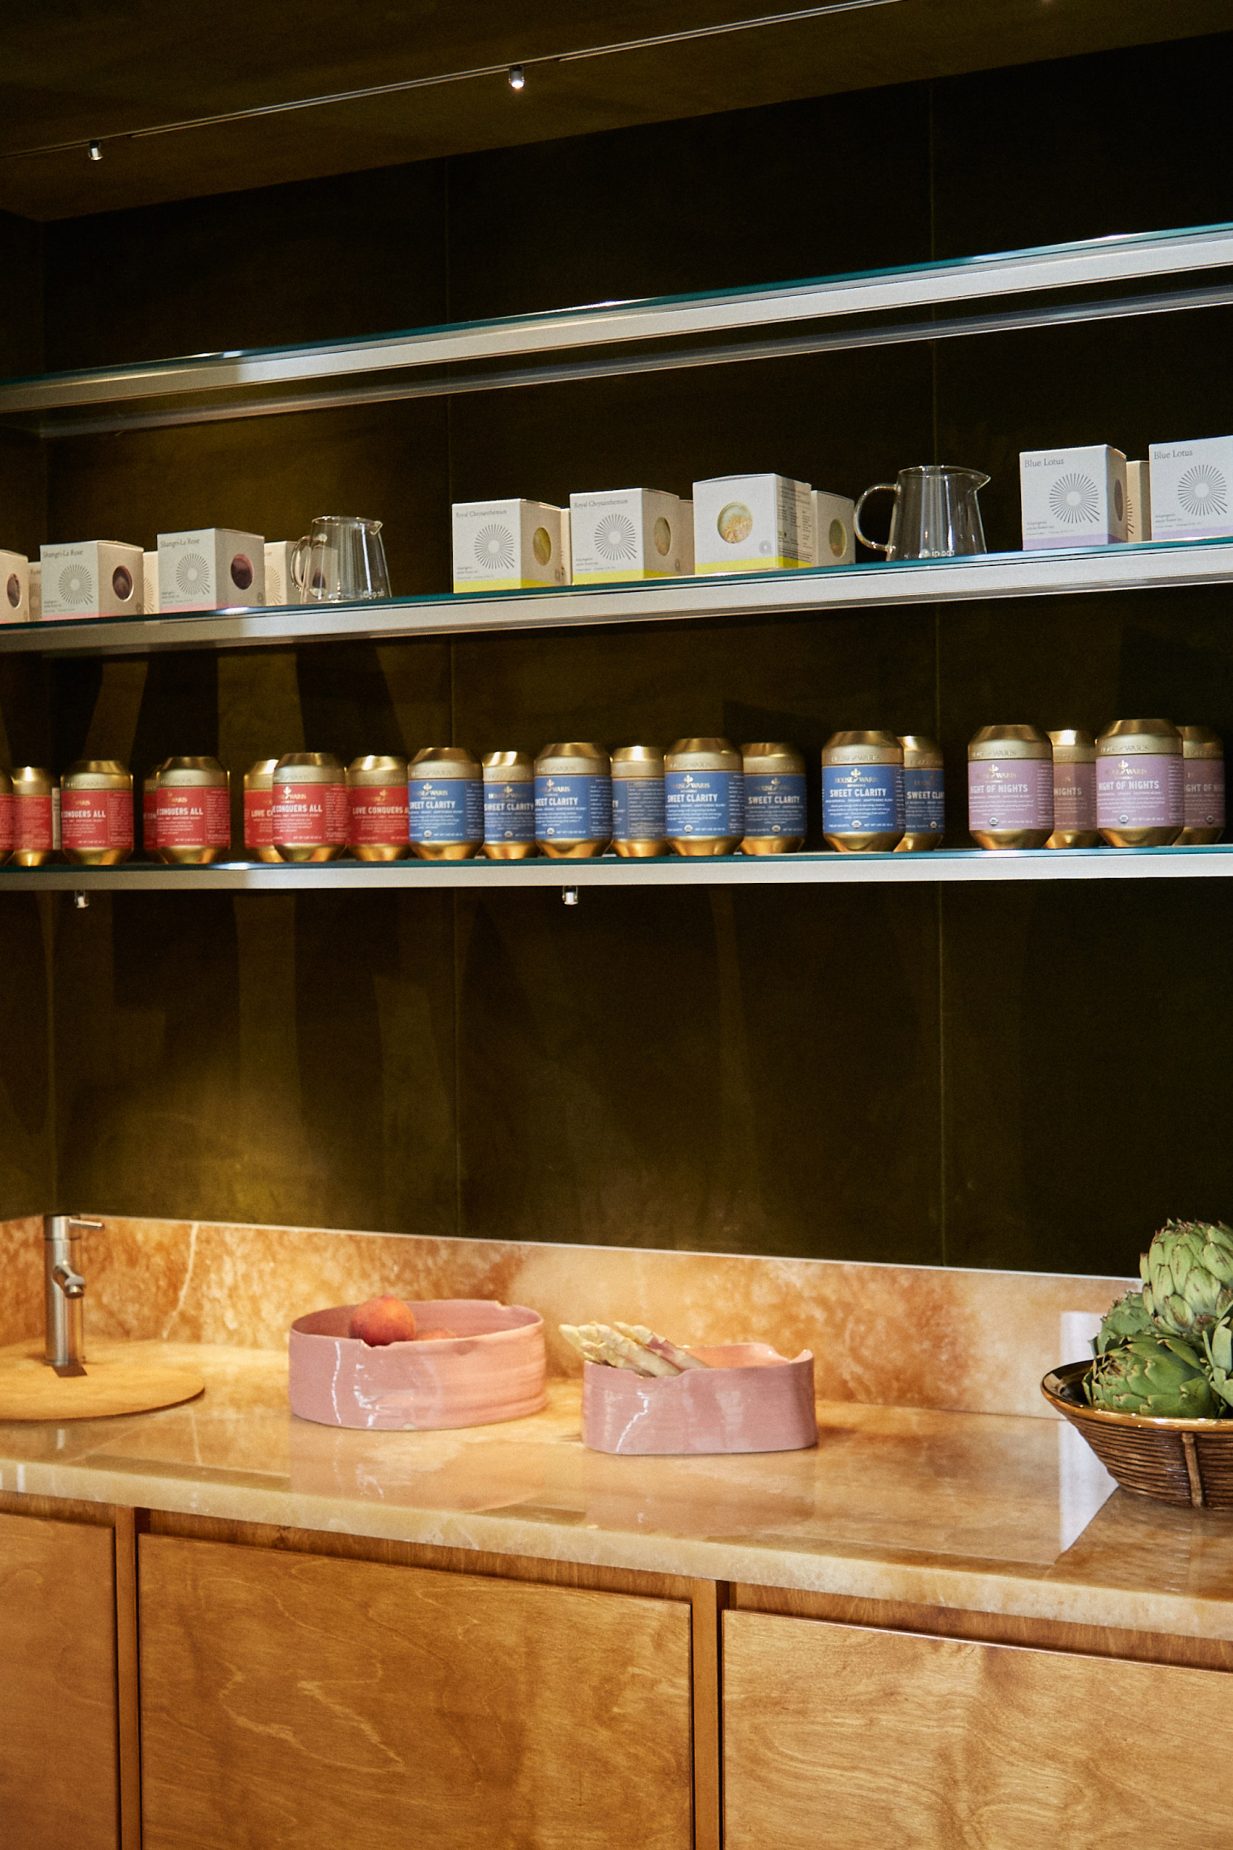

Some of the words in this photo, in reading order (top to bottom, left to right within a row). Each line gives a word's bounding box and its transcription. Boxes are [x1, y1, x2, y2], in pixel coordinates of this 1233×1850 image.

[1154, 450, 1171, 460] Blue
[1172, 449, 1193, 459] Lotus
[1024, 459, 1042, 468] Blue
[1044, 458, 1065, 467] Lotus
[986, 784, 997, 793] OF
[998, 783, 1029, 793] NIGHTS
[1115, 780, 1126, 790] OF
[1128, 780, 1160, 790] NIGHTS
[686, 793, 718, 802] CLARITY
[829, 788, 852, 798] SWEET
[854, 788, 887, 797] CLARITY
[907, 791, 931, 800] SWEET
[425, 800, 456, 810] CLARITY
[548, 797, 579, 806] CLARITY
[748, 796, 772, 805] SWEET
[189, 807, 204, 816] ALL
[309, 804, 323, 813] ALL
[368, 806, 404, 815] CONQUERS
[93, 809, 106, 819] ALL
